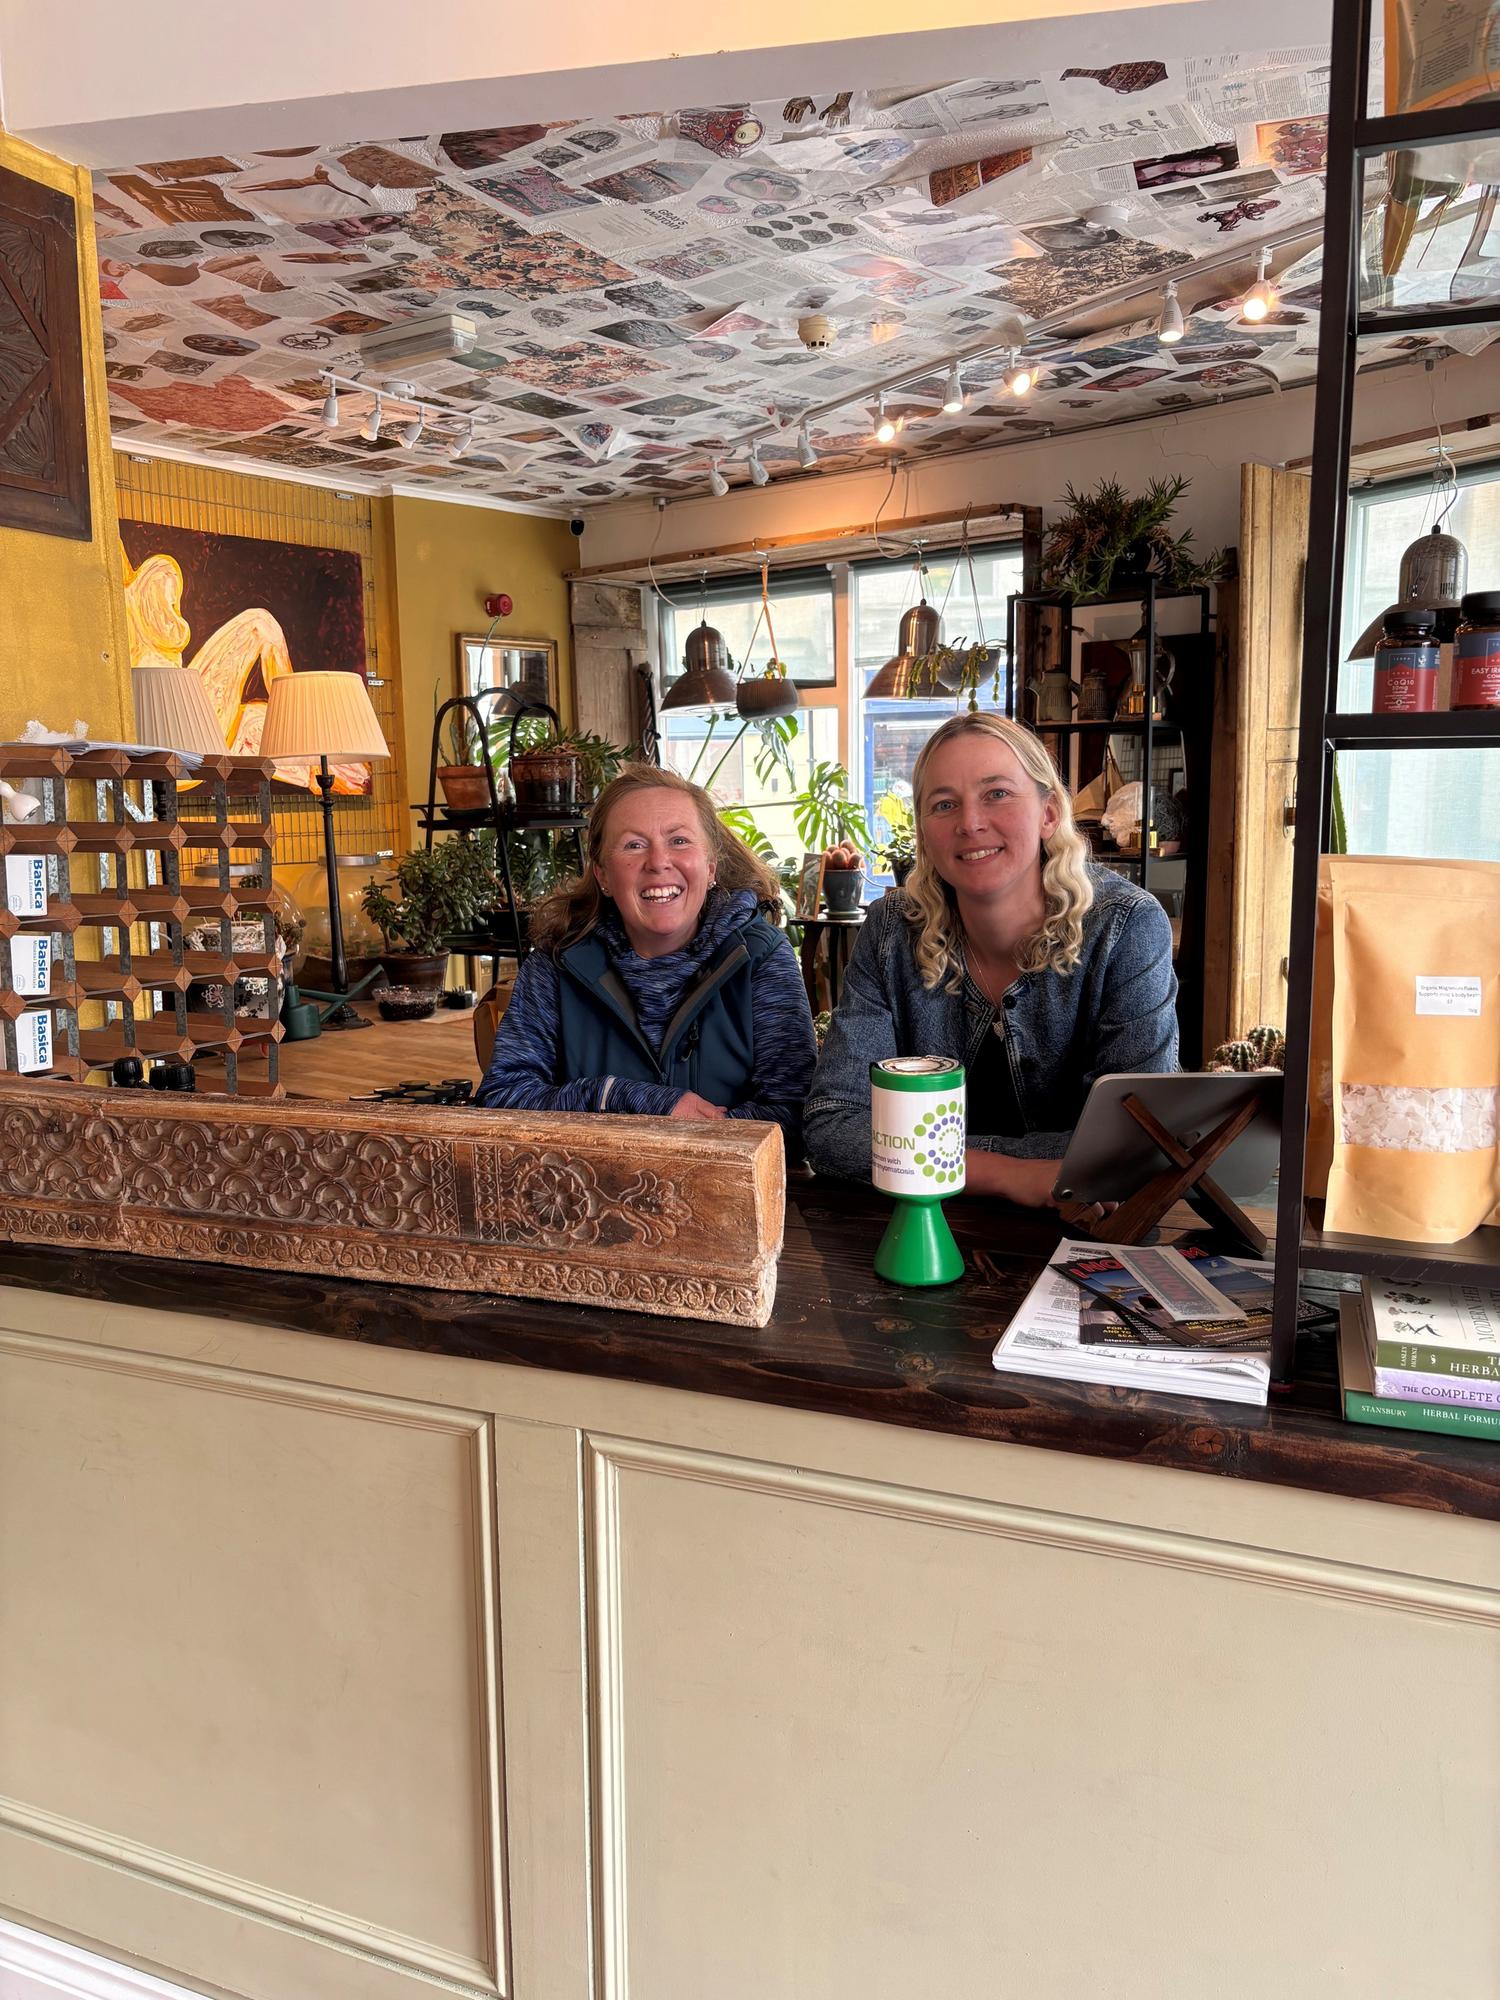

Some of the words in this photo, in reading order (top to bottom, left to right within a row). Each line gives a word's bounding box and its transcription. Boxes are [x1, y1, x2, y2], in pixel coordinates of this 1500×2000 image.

[1471, 667, 1490, 675] EASY
[33, 859, 44, 909] Basica
[37, 939, 48, 989] Basica
[37, 1015, 49, 1064] Basica
[887, 1157, 902, 1165] with
[1488, 1355, 1500, 1366] T
[1402, 1385, 1419, 1393] THE
[1421, 1386, 1493, 1402] COMPLETE
[1361, 1405, 1407, 1417] STANSBURY
[1422, 1408, 1461, 1420] HERBAL
